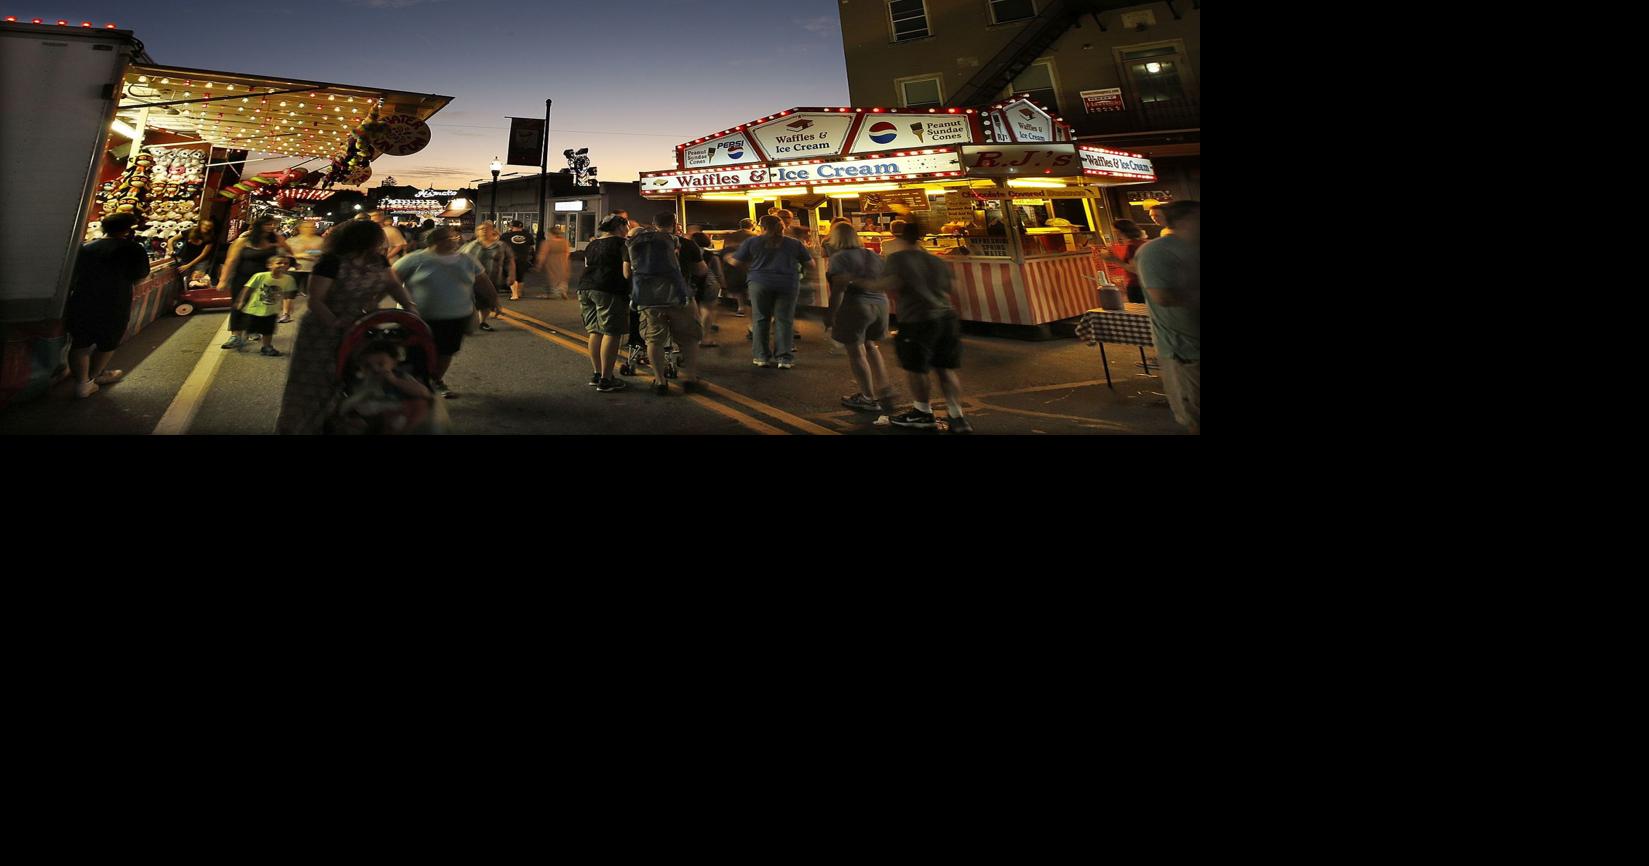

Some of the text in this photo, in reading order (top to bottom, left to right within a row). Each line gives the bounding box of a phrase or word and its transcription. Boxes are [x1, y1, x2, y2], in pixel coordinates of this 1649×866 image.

[927, 120, 962, 129] Peanut
[1018, 122, 1038, 132] Waffles
[927, 126, 964, 136] Sundae
[1019, 131, 1045, 141] Ice Cream
[776, 131, 828, 144] Waffles &
[931, 133, 962, 141] Cones
[716, 140, 745, 150] PEPSI
[776, 141, 830, 153] Ice Cream
[1086, 154, 1113, 168] Waffles
[1119, 158, 1130, 169] Ice
[1129, 160, 1150, 171] Cream
[676, 162, 901, 187] Waffles & Ice Cream
